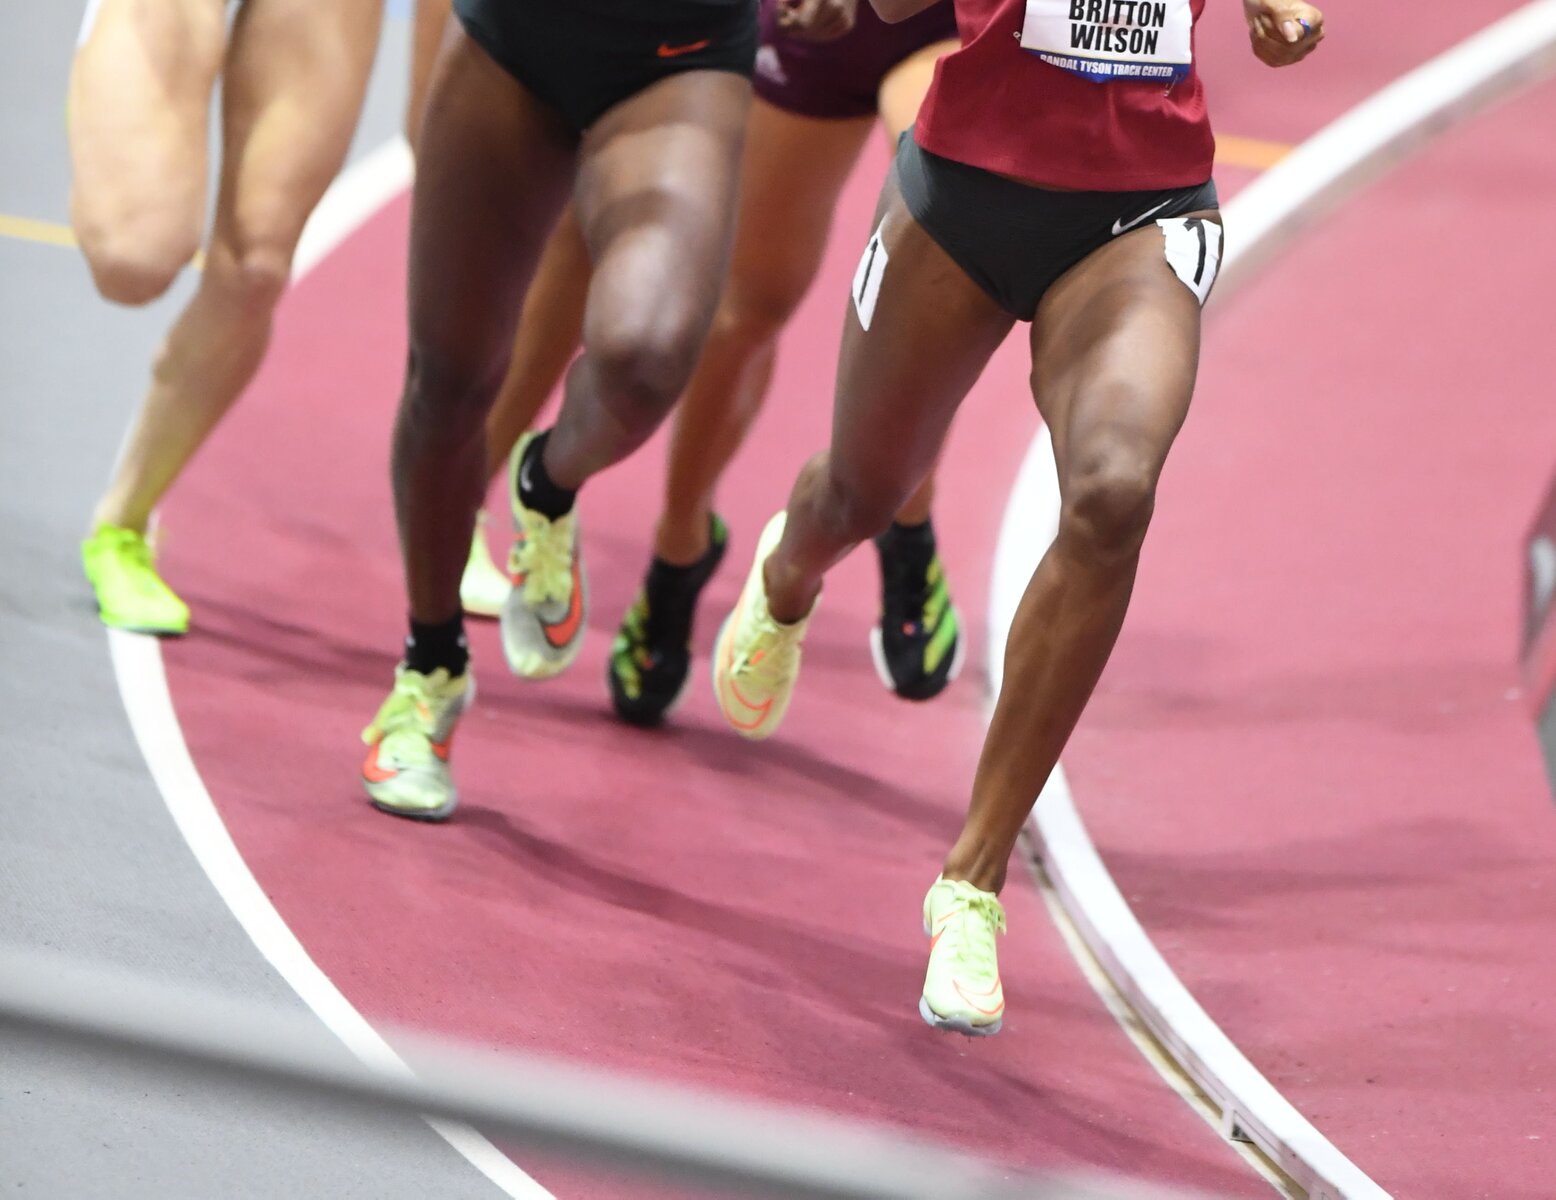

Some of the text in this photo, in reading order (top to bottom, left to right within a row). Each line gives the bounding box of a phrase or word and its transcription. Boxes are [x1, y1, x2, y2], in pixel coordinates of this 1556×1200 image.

[1070, 23, 1159, 55] WILSON
[1080, 60, 1112, 75] TYSON
[1113, 64, 1141, 77] TRACK
[1141, 66, 1174, 77] CENTER
